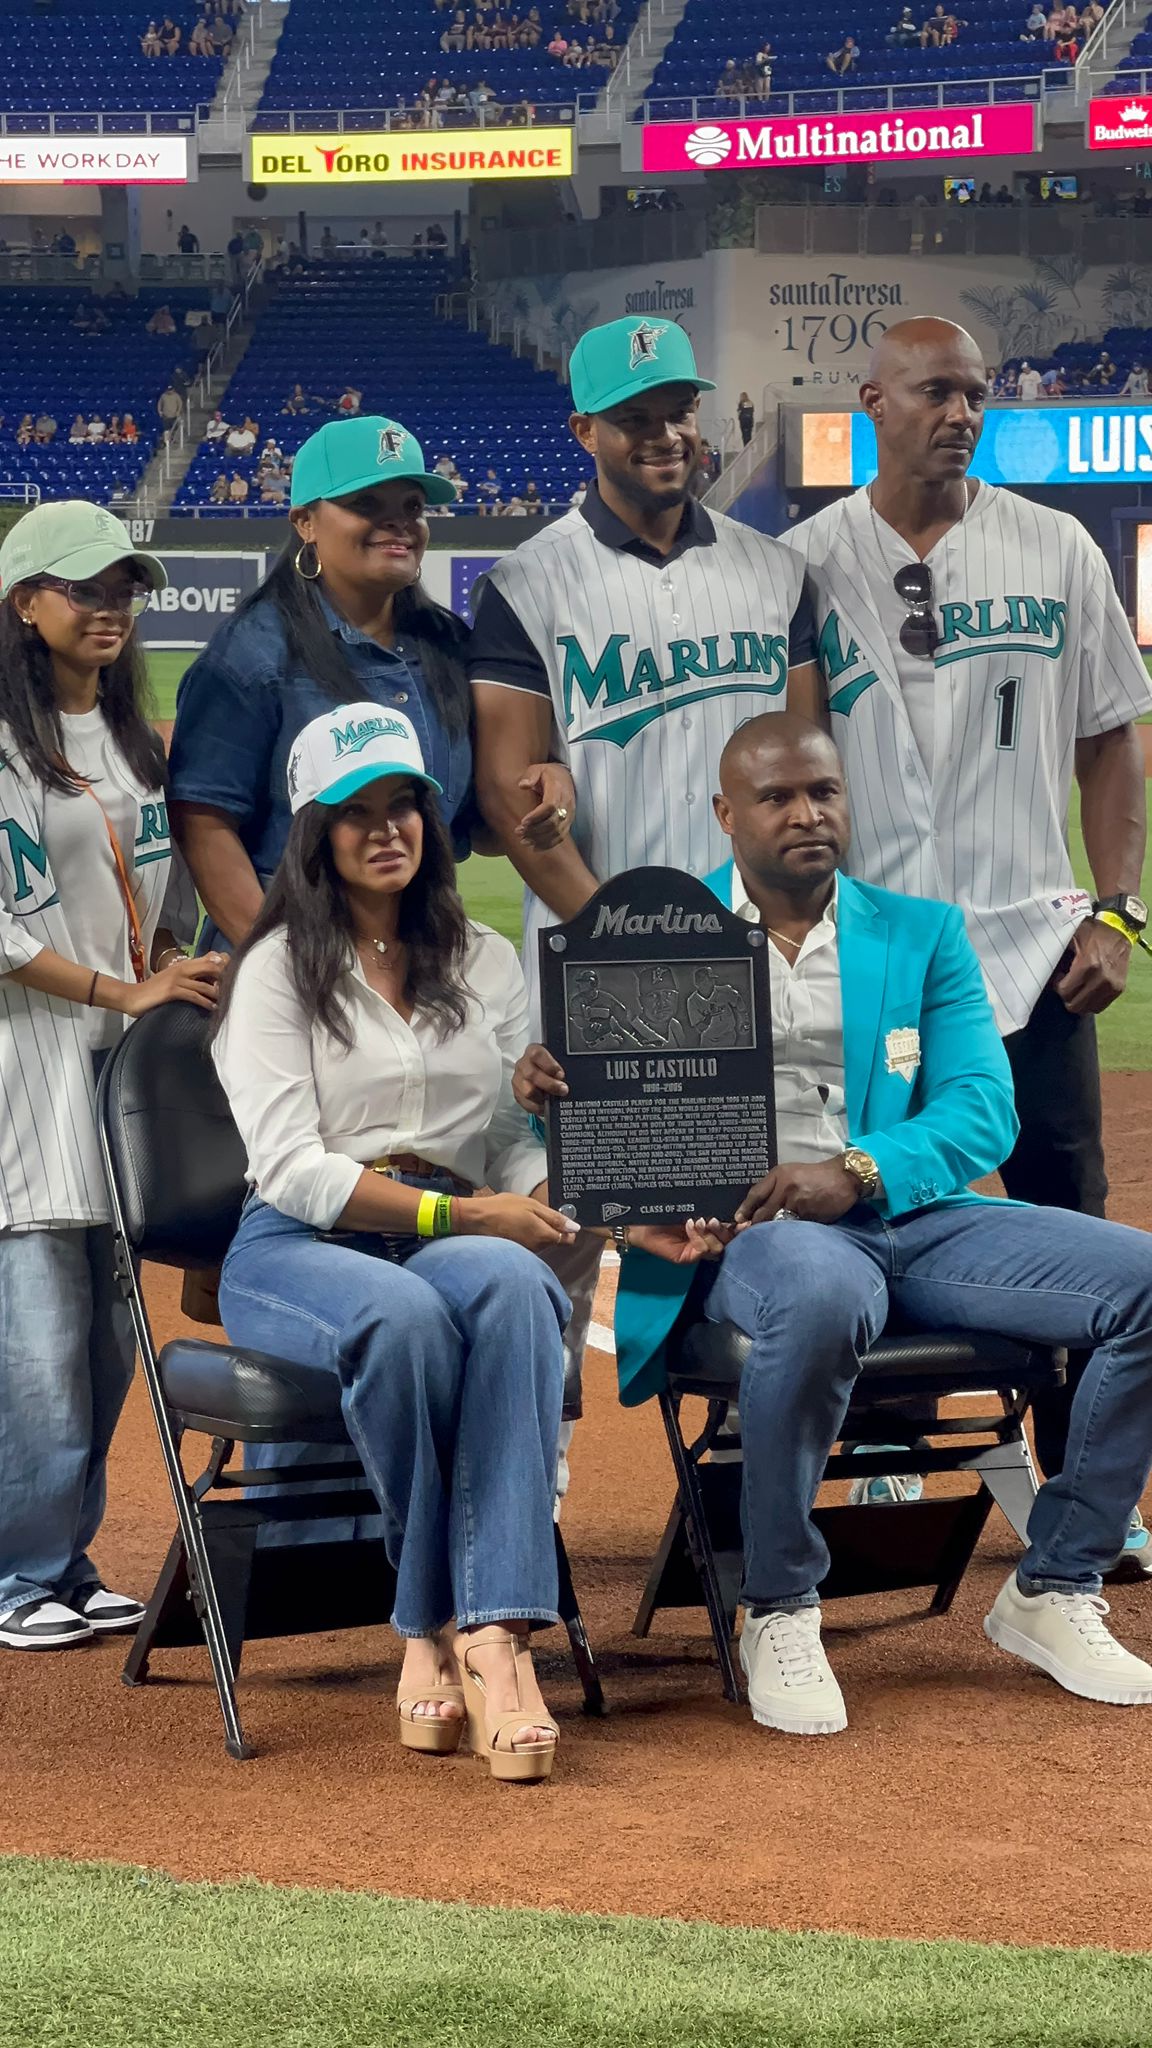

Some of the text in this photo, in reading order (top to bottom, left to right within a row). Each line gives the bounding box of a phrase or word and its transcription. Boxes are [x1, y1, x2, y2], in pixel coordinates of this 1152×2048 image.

[736, 114, 984, 160] Multinational
[1094, 123, 1152, 141] Budwei
[38, 153, 160, 168] WORKDAY
[262, 145, 561, 173] DEL TORO INSURANCE
[625, 280, 694, 313] santaTeresa
[769, 273, 902, 306] santaTeresa
[147, 586, 236, 613] ABOVE
[556, 632, 787, 727] MARLINS
[995, 676, 1022, 751] 1
[329, 717, 409, 758] MARLINS
[590, 903, 723, 939] Marlins
[606, 1057, 718, 1080] LUIS CASTILLO
[640, 1204, 695, 1213] CLASS OF 2025
